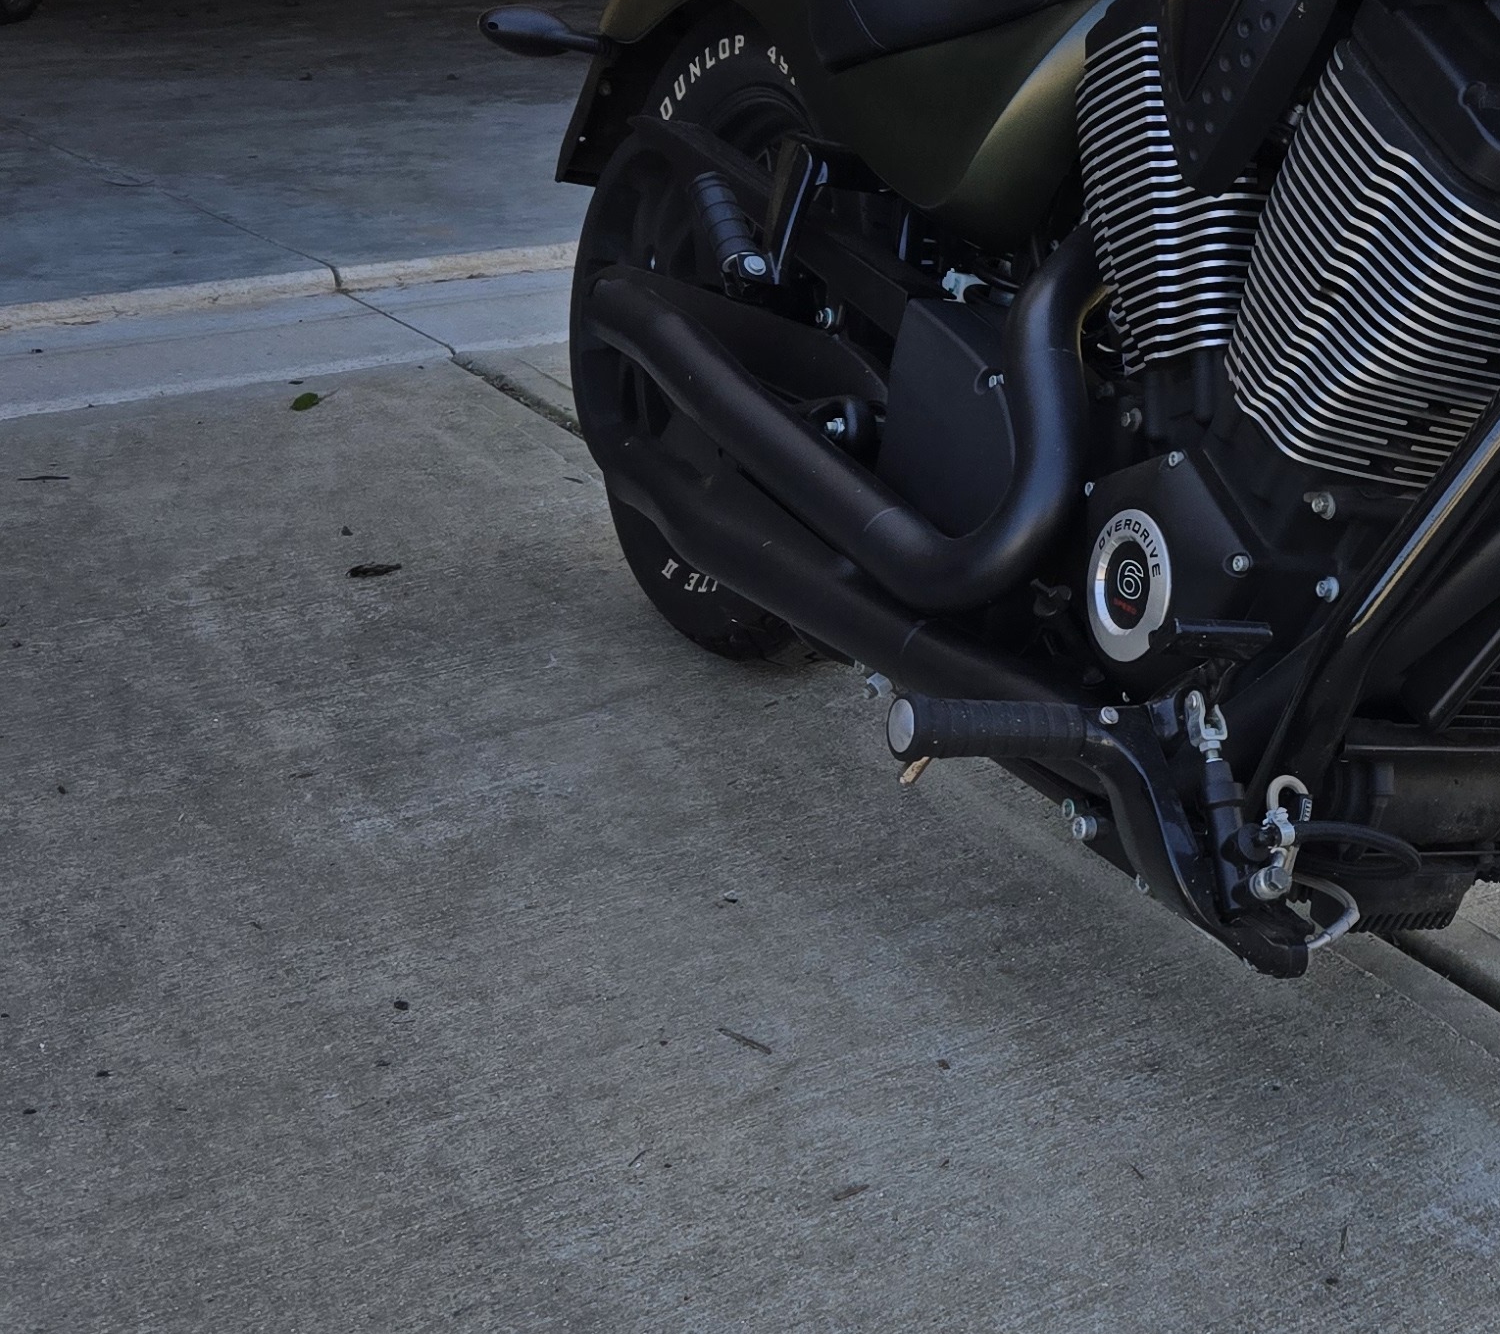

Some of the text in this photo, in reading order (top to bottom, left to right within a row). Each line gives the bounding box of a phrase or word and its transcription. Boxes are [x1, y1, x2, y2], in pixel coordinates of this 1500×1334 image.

[659, 34, 745, 121] DUNLOP
[1098, 518, 1161, 578] OVERDRIVE
[1117, 559, 1144, 600] 6
